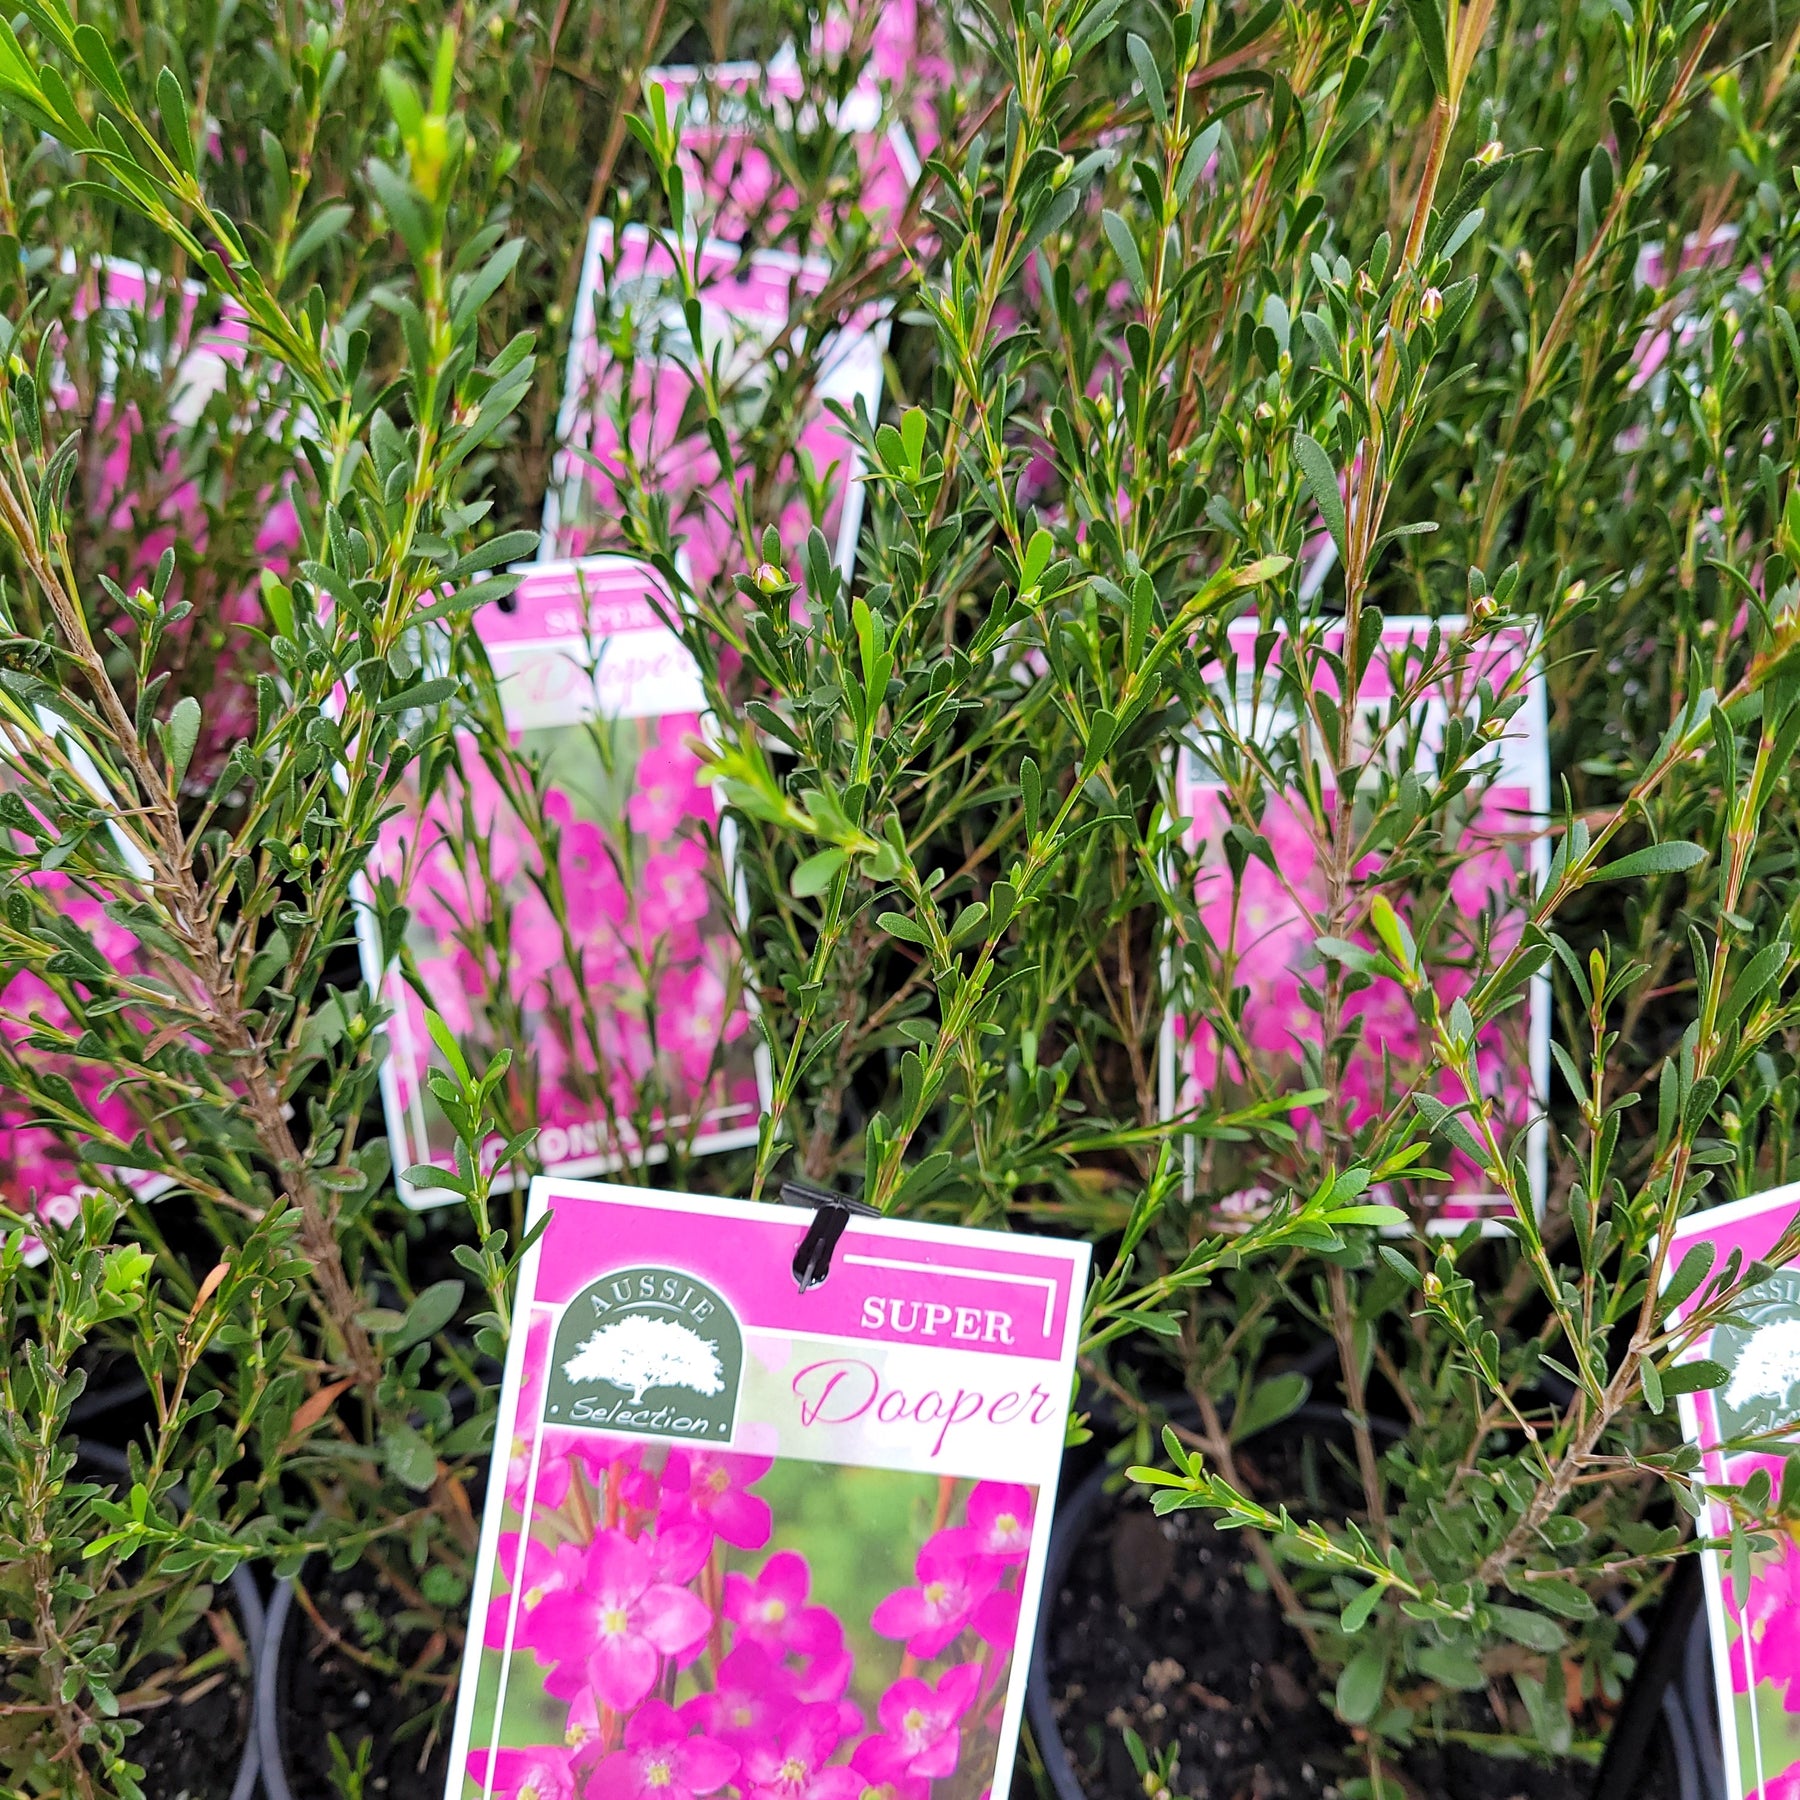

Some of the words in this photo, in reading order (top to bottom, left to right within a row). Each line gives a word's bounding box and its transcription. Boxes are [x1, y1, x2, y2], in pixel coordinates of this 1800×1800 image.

[590, 1274, 716, 1325] AUSSIE
[861, 1296, 1016, 1346] SUPER
[569, 1397, 710, 1434] Selection
[792, 1358, 1057, 1458] Dooper
